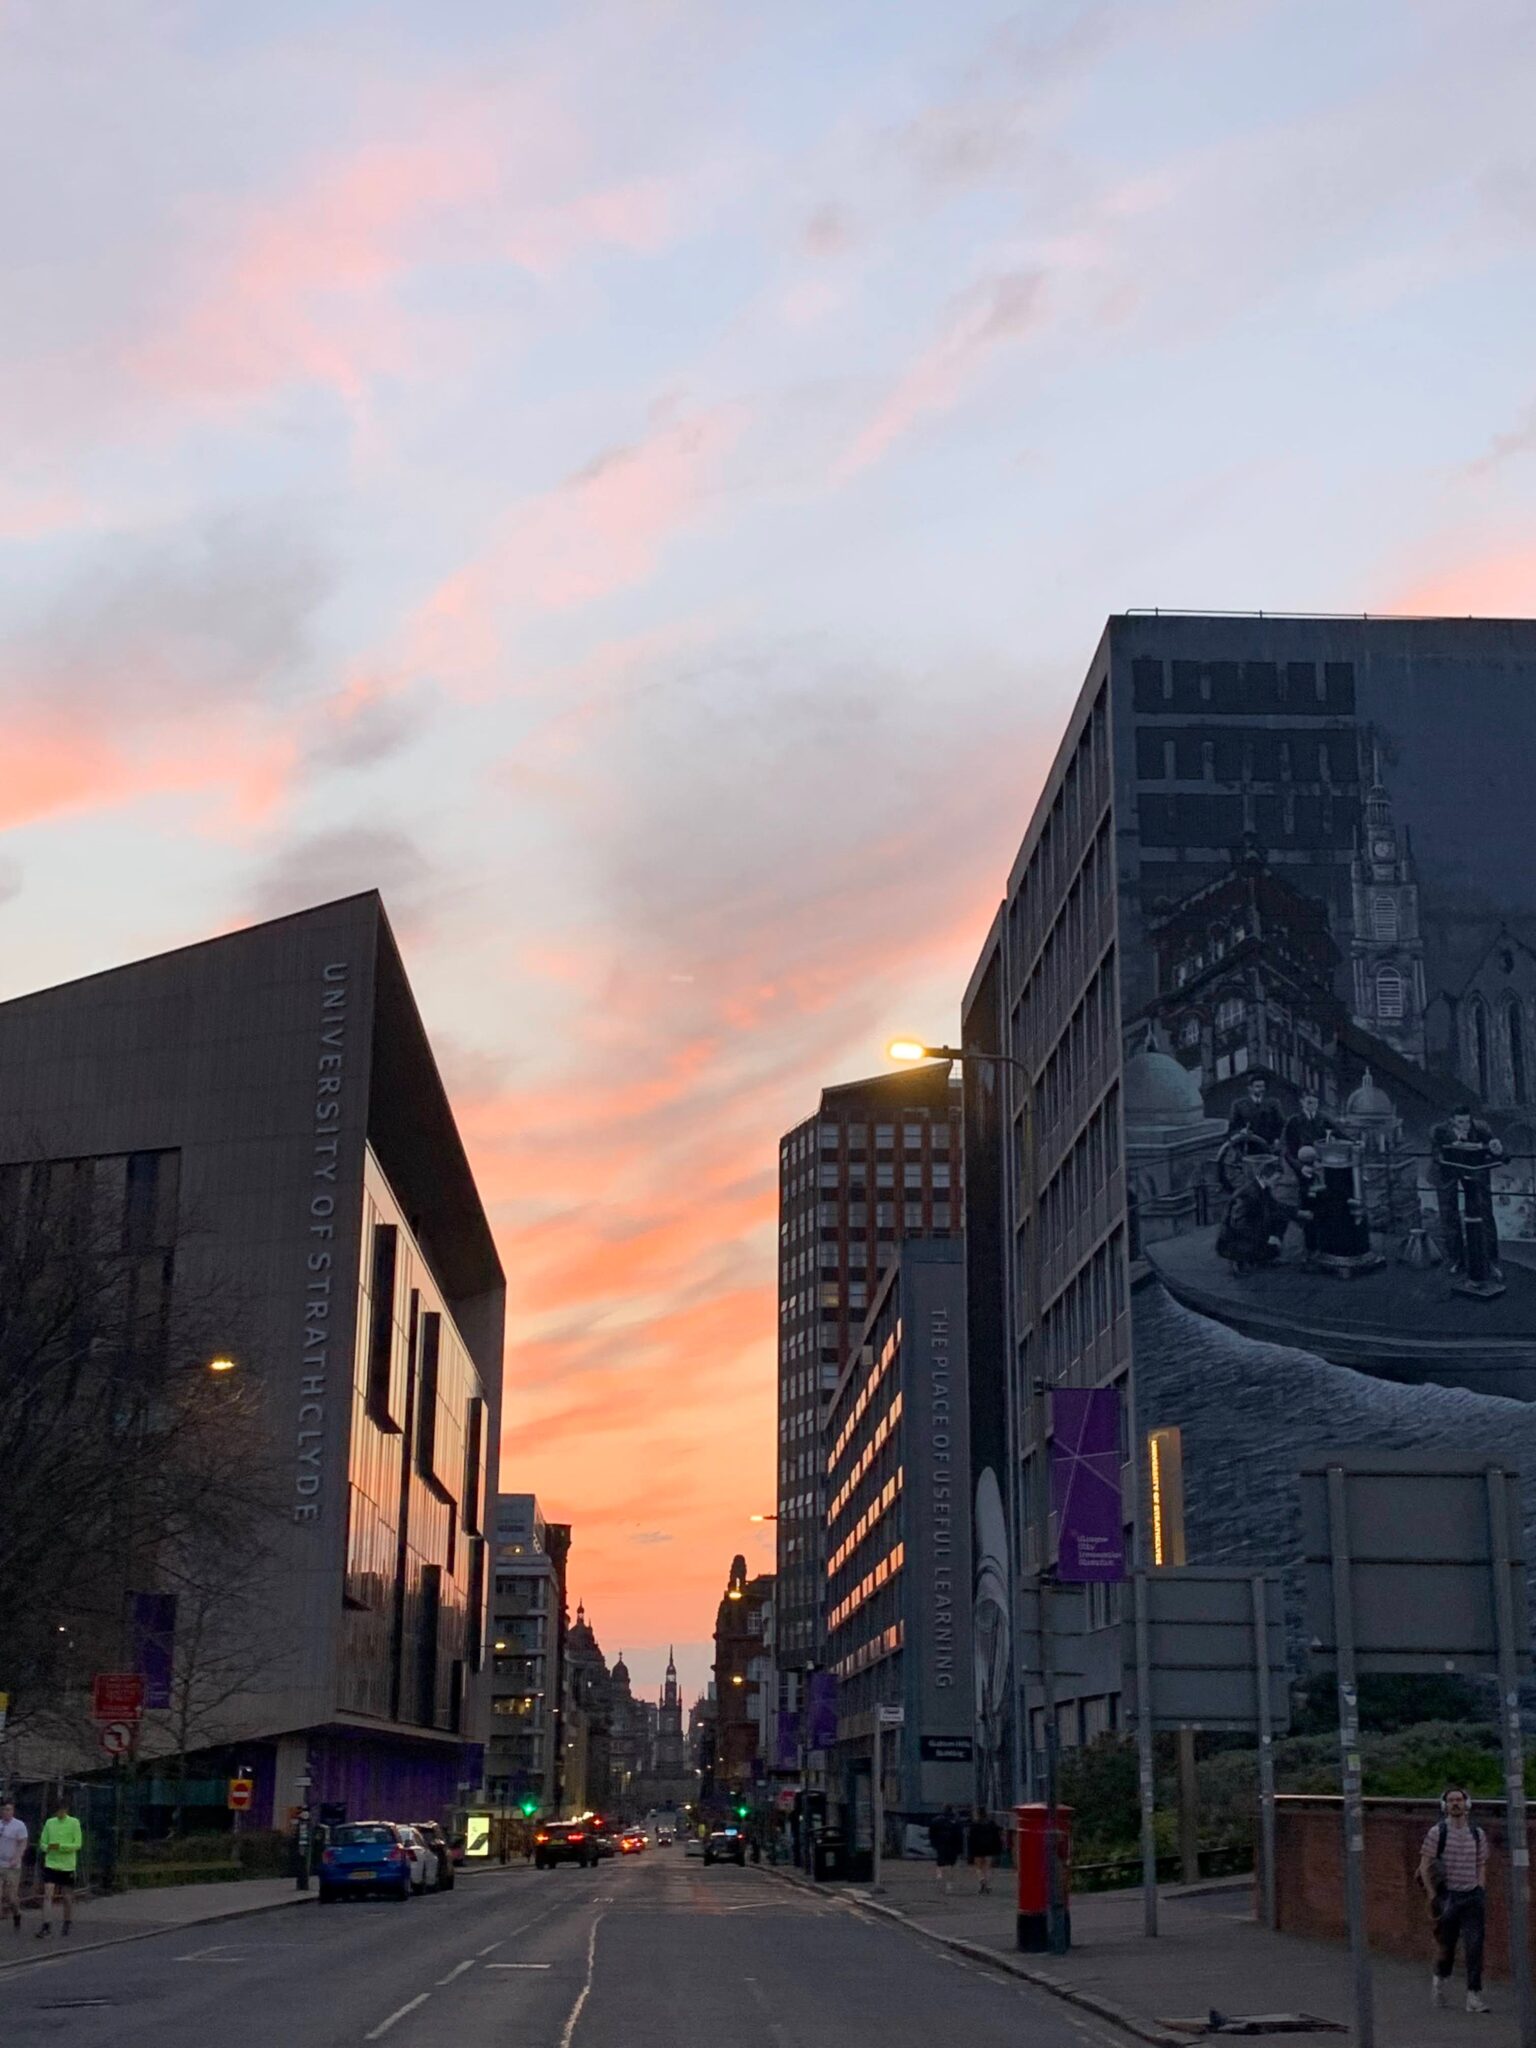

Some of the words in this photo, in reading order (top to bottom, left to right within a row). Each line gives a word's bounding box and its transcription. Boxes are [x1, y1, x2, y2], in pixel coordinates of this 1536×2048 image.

[313, 962, 349, 1181] UNIVERSITY
[310, 1195, 335, 1240] OF
[930, 1308, 949, 1348] THE
[294, 1252, 332, 1522] STRATHCLYDE
[931, 1356, 950, 1426] PLACE
[932, 1434, 951, 1463] OF
[1151, 1440, 1160, 1490] UNIVERSITY
[932, 1470, 952, 1558] USEFUL
[1153, 1491, 1161, 1503] OF
[1153, 1504, 1162, 1565] STRATHCLYDE
[933, 1566, 953, 1689] LEARNING
